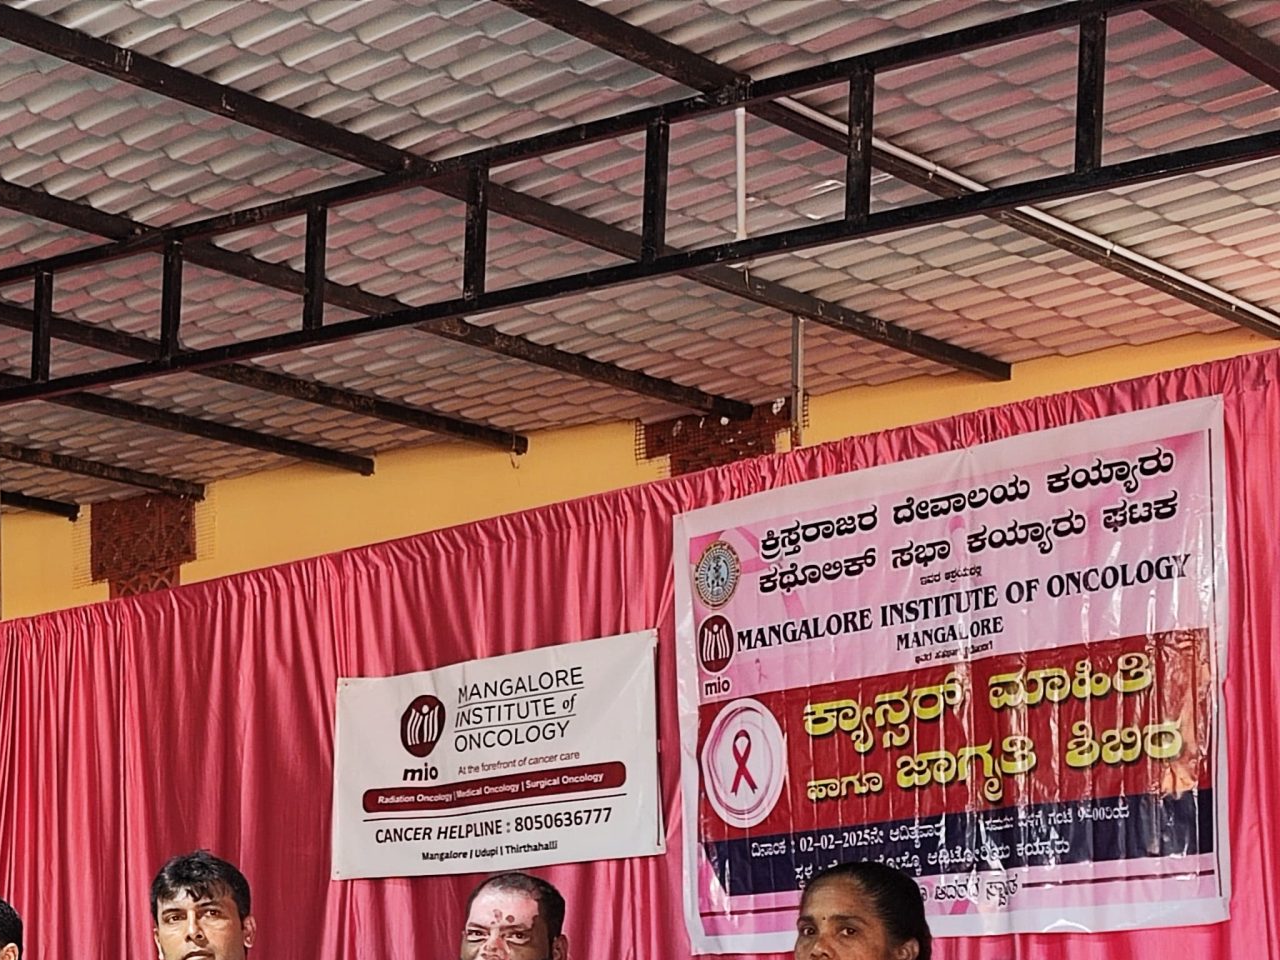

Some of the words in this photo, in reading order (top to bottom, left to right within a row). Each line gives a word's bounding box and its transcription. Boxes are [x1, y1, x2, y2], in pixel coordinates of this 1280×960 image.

[761, 504, 878, 559] ಕ್ರಿಸ್ತರಾಜರ
[893, 474, 1030, 525] ದೇವಾಲಯ
[1047, 447, 1174, 493] ಕಯ್ಯಾರು
[892, 539, 951, 568] ಸಭಾ
[967, 508, 1086, 554] ಕಯ್ಯಾರು
[1103, 490, 1178, 532] ಘಟಕ
[737, 607, 874, 652] MANGALORE
[881, 585, 999, 627] INSTITUTE
[1006, 578, 1040, 603] OF
[1046, 553, 1192, 598] ONCOLOGY
[896, 616, 1004, 651] MANGALORE
[458, 666, 584, 704] MANGALORE
[705, 676, 730, 695] mio
[455, 697, 556, 728] INSTITUTE
[562, 693, 578, 713] of
[803, 671, 963, 754] ಕ್ಯಾನ್ಸರ್
[988, 652, 1153, 709] ಮಾಹಿತಿ
[454, 720, 570, 752] ONCOLOGY
[402, 762, 438, 781] mio
[458, 765, 467, 776] At
[467, 764, 480, 775] the
[481, 759, 517, 772] forefront
[518, 757, 527, 767] of
[528, 754, 558, 766] cancer
[559, 751, 580, 761] care
[807, 771, 883, 800] ಹಾಗೂ
[896, 735, 1036, 802] ಜಾಗೃತಿ
[1065, 718, 1183, 767] ಶಿಬಿರ
[377, 794, 415, 804] Radiation
[416, 791, 453, 803] Oncology
[456, 785, 482, 798] Medical
[483, 782, 520, 795] Oncology
[526, 777, 560, 790] Surgical
[561, 771, 604, 784] Oncology
[375, 826, 432, 844] CANCER
[436, 819, 503, 841] HELPLINE
[514, 806, 613, 832] 8050636777
[422, 850, 468, 863] Mangalore
[474, 847, 499, 859] Udupi
[504, 841, 558, 855] Thirthahalli
[751, 838, 787, 857] ದಿನಾಂಕ
